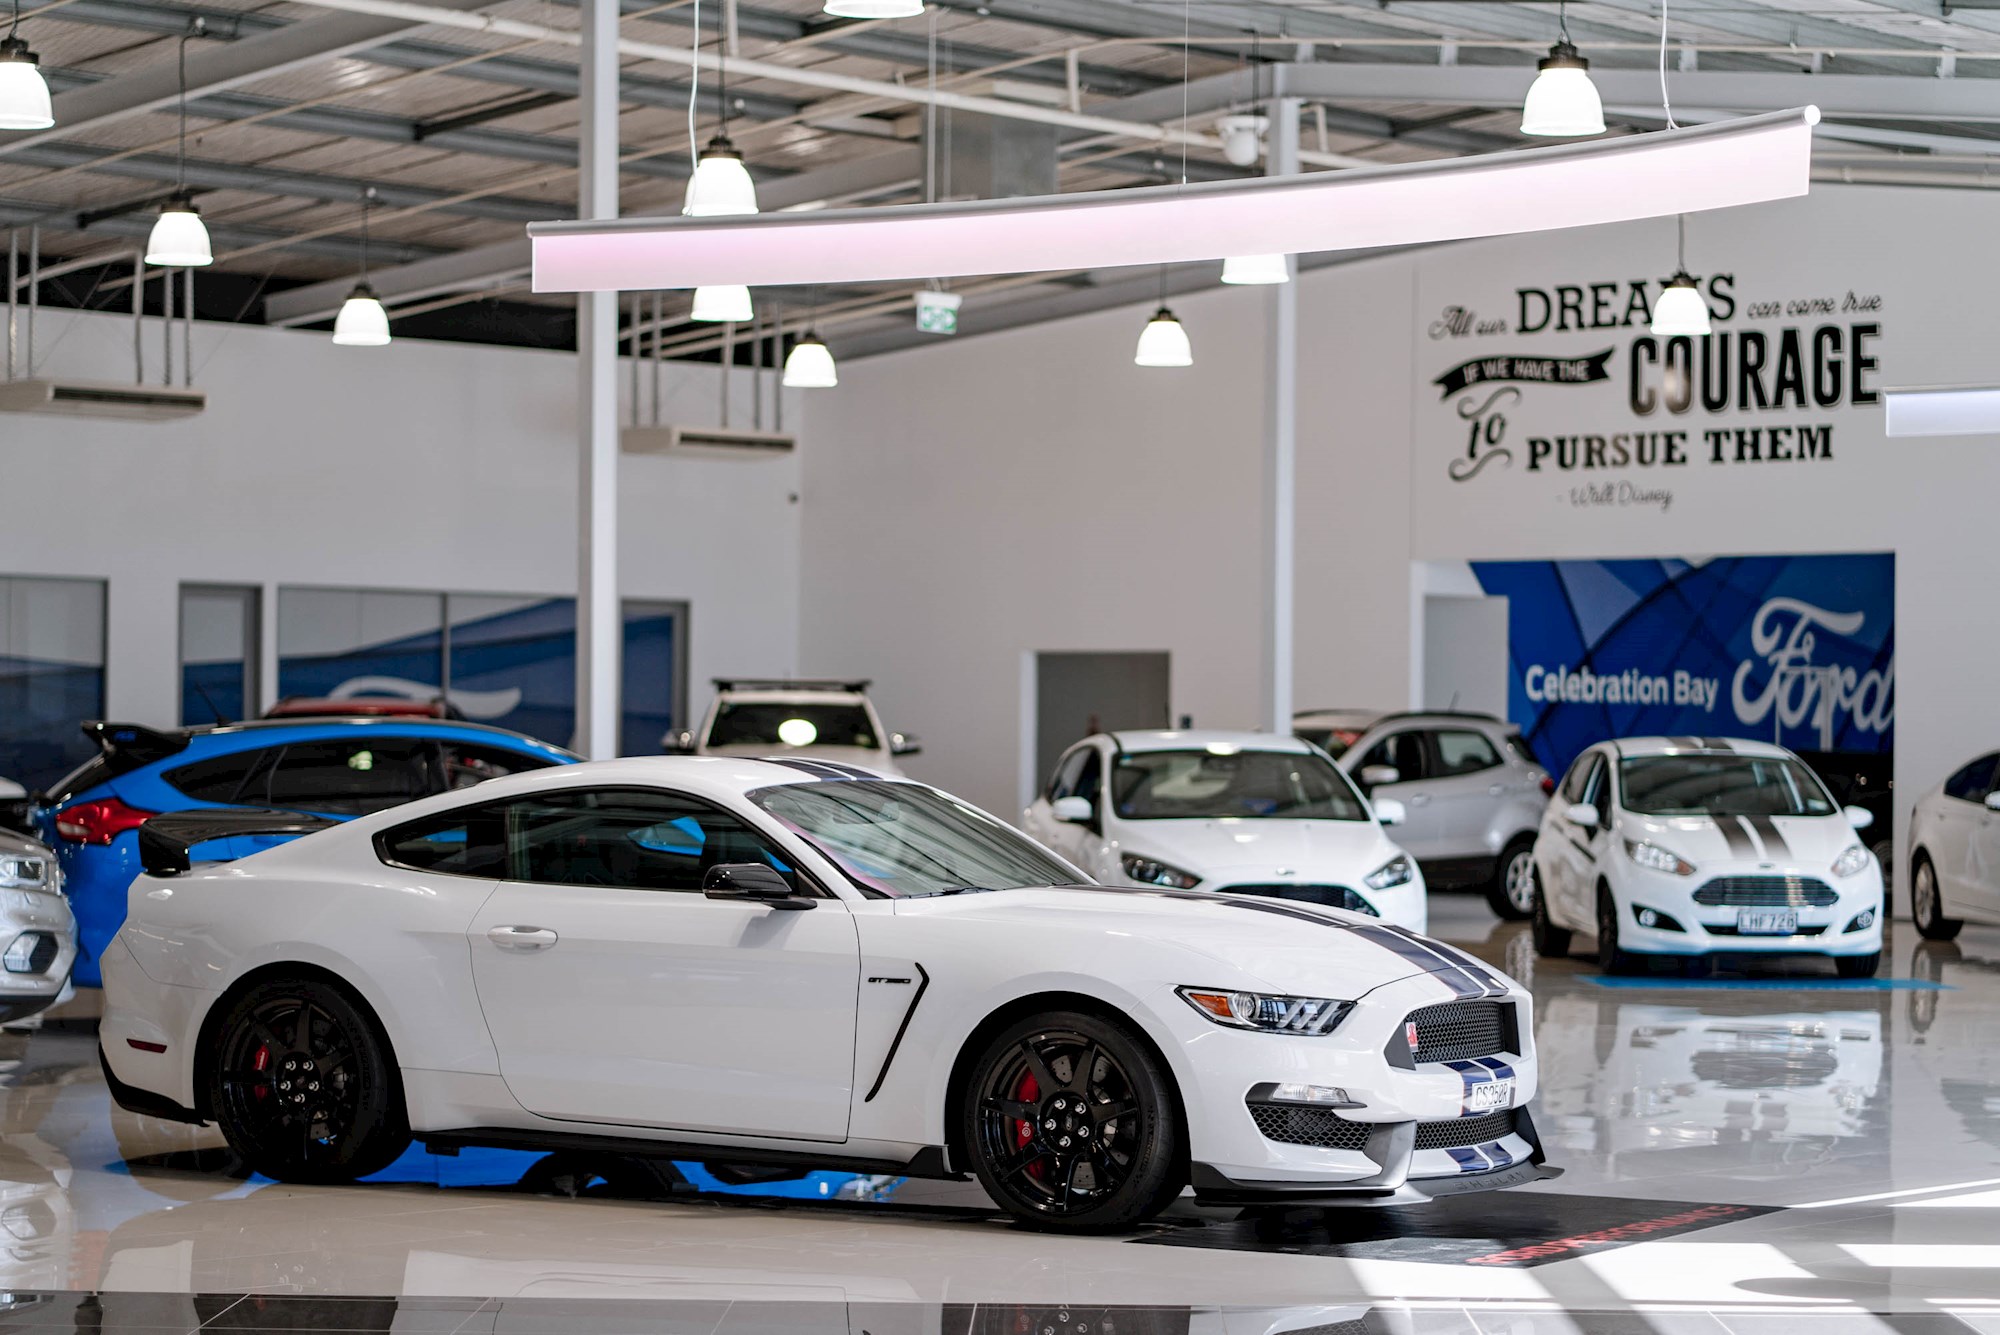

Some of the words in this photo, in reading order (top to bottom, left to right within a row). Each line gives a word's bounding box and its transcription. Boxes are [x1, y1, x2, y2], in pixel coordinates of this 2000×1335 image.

[1428, 304, 1476, 340] All
[1475, 319, 1507, 336] our
[1515, 273, 1736, 335] DREAS
[1747, 301, 1782, 319] can
[1787, 297, 1836, 316] come
[1841, 288, 1882, 314] true
[1462, 362, 1481, 385] IF
[1481, 357, 1510, 379] WE
[1513, 359, 1556, 382] HAVE
[1556, 360, 1592, 382] THE
[1628, 321, 1882, 417] COURAGE
[1526, 430, 1688, 471] PURSUE
[1704, 423, 1835, 464] THEM
[1568, 482, 1615, 507] Walt
[1617, 479, 1673, 513] Disney
[1525, 663, 1668, 704] Celebration
[1673, 669, 1719, 713] Bay
[1732, 597, 1895, 733] Ford
